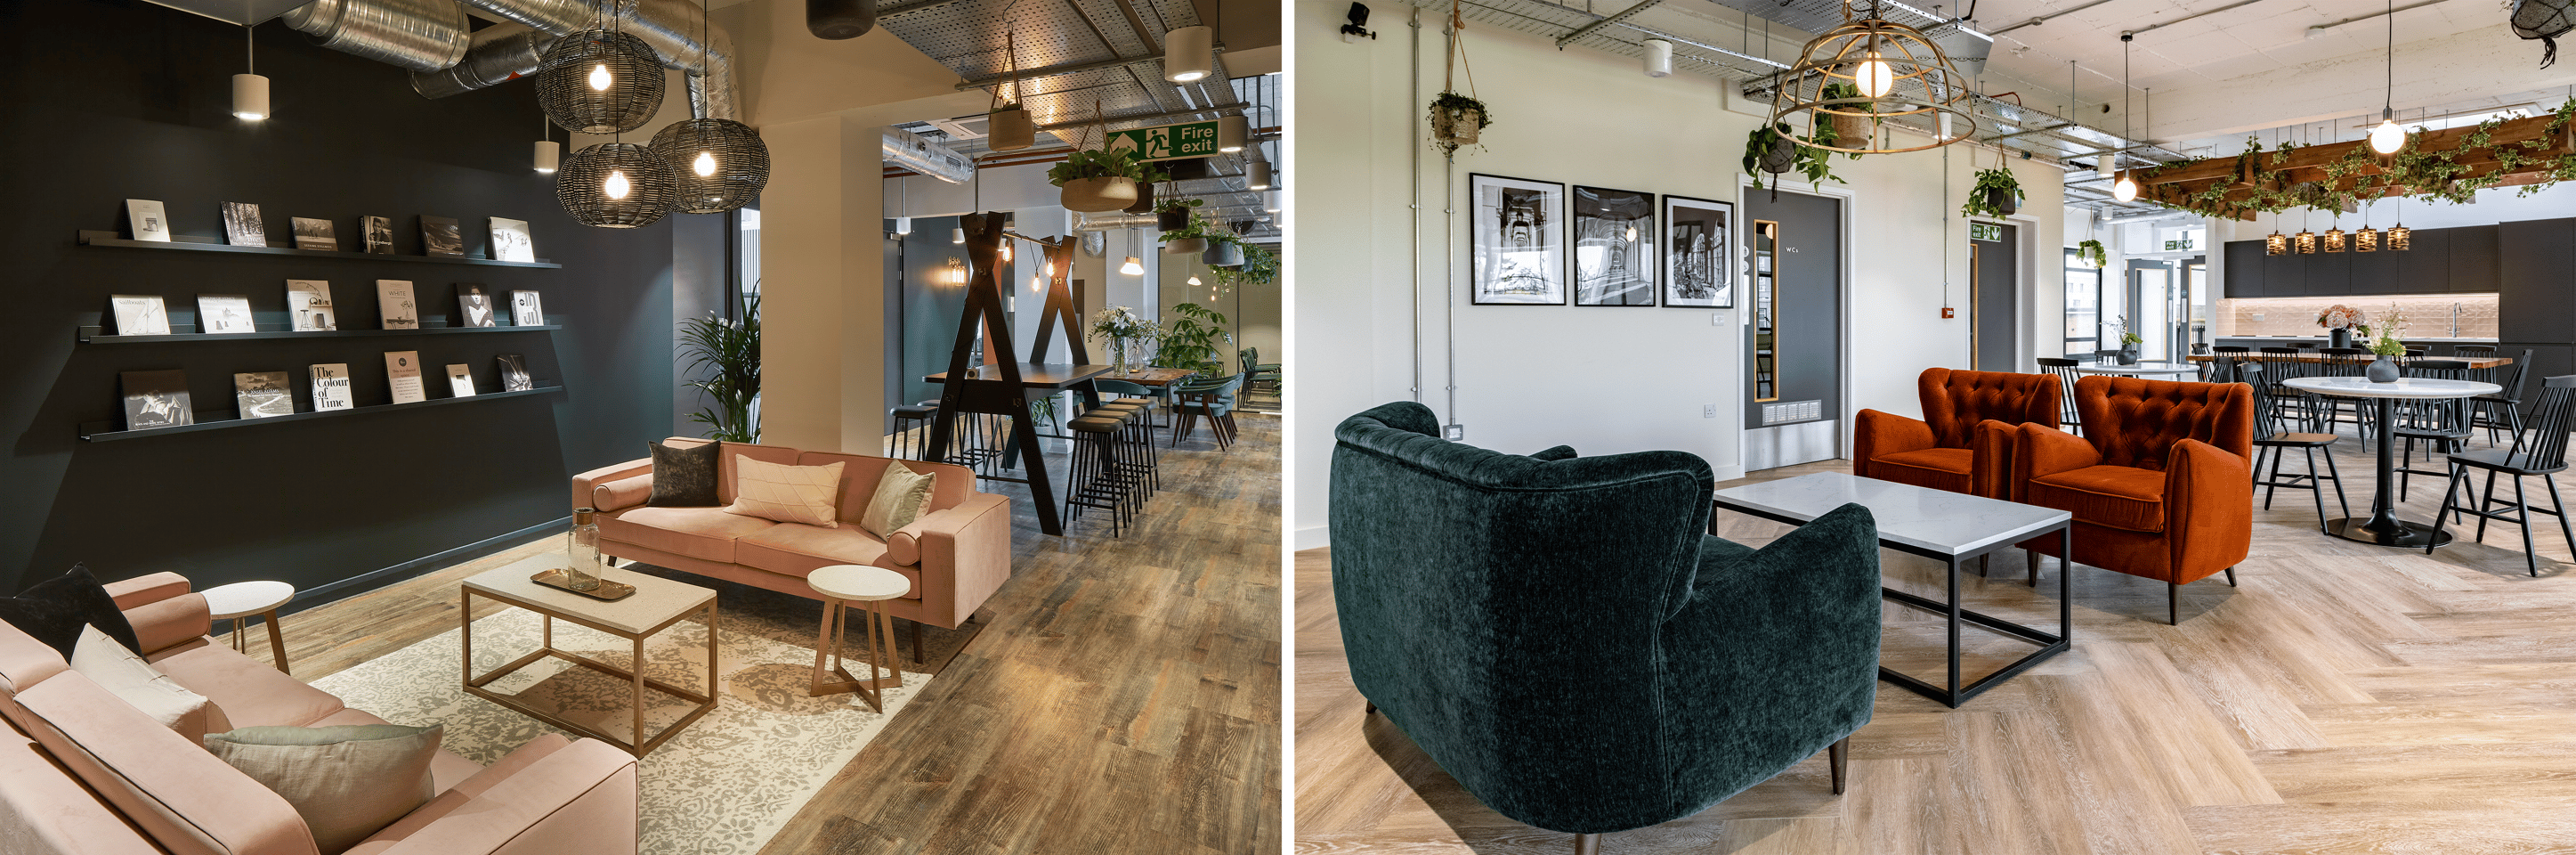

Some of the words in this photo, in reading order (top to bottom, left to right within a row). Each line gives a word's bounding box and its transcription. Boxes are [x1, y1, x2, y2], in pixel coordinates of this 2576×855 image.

[1181, 126, 1214, 140] Fire
[1181, 139, 1212, 153] exit
[314, 366, 334, 378] The
[316, 377, 348, 388] Colour
[318, 387, 328, 398] of
[319, 397, 344, 408] Time
